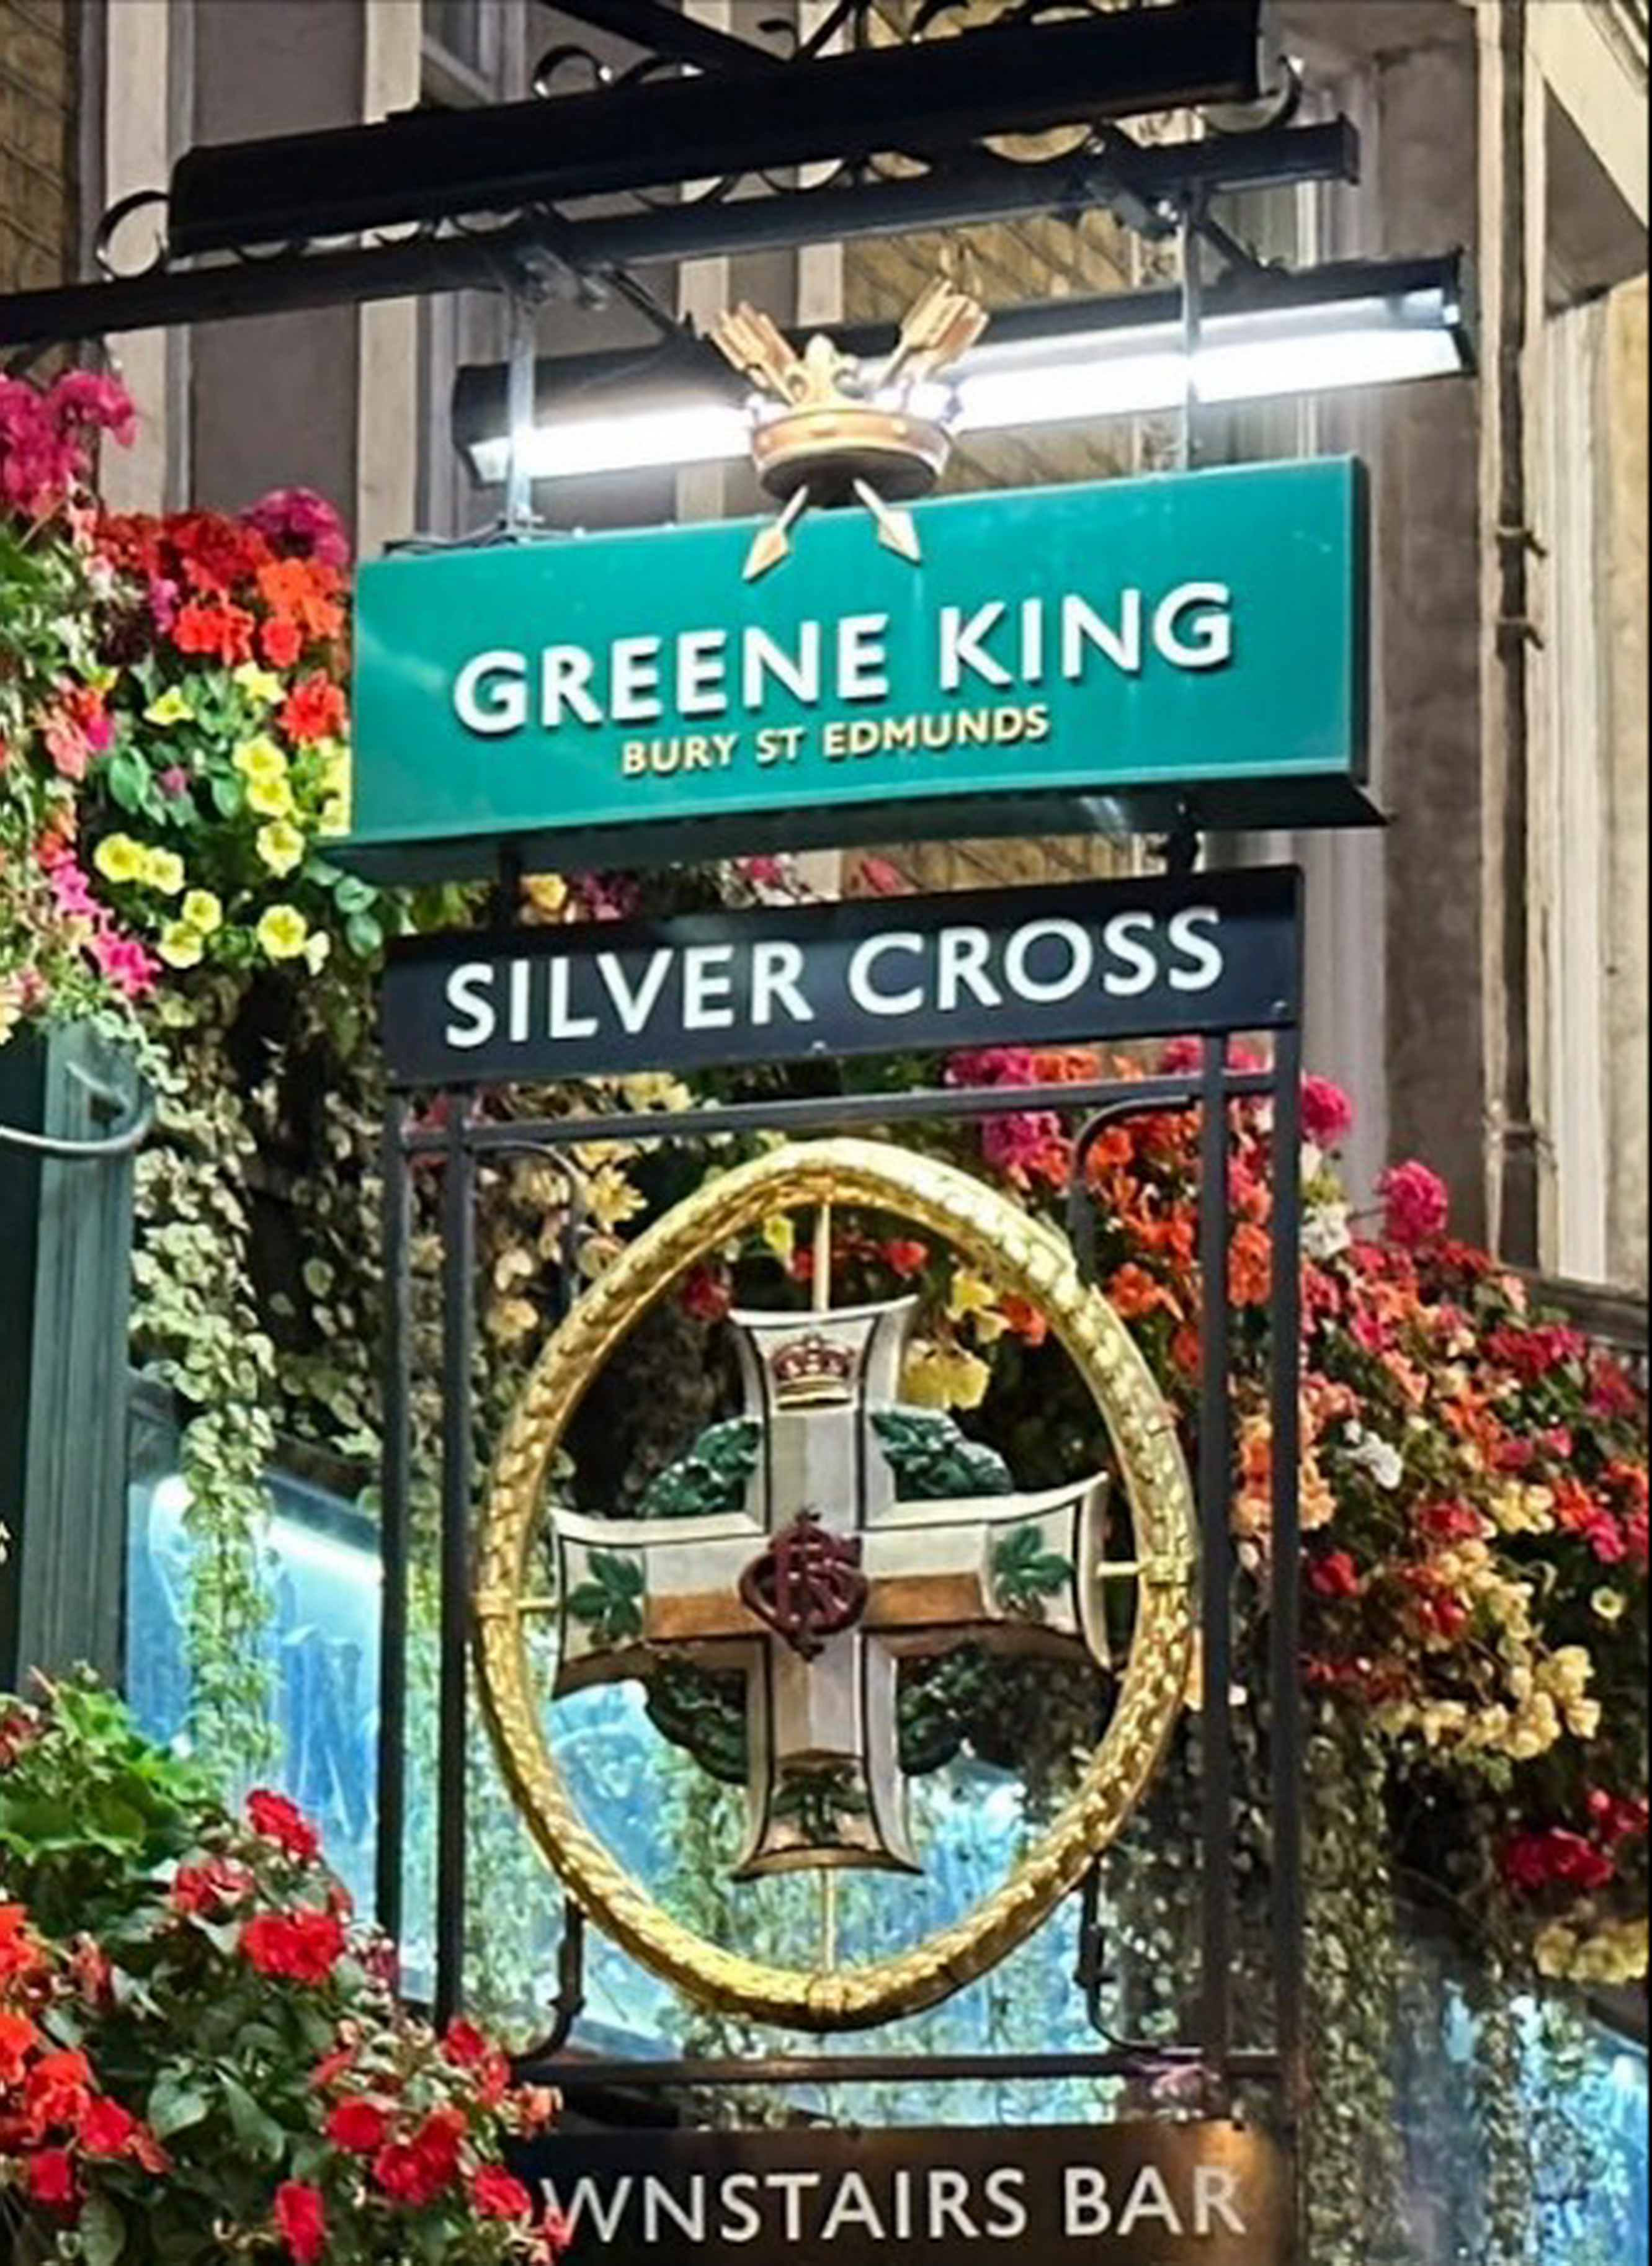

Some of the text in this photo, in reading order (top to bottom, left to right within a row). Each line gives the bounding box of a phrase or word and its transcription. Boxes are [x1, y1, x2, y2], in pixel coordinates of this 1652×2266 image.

[453, 582, 1231, 735] GREENE KING
[620, 703, 1050, 775] BURY ST EDMUNDS
[445, 908, 1223, 1047] SILVER CROSS
[541, 2164, 1247, 2244] WNSTAIRS BAR
